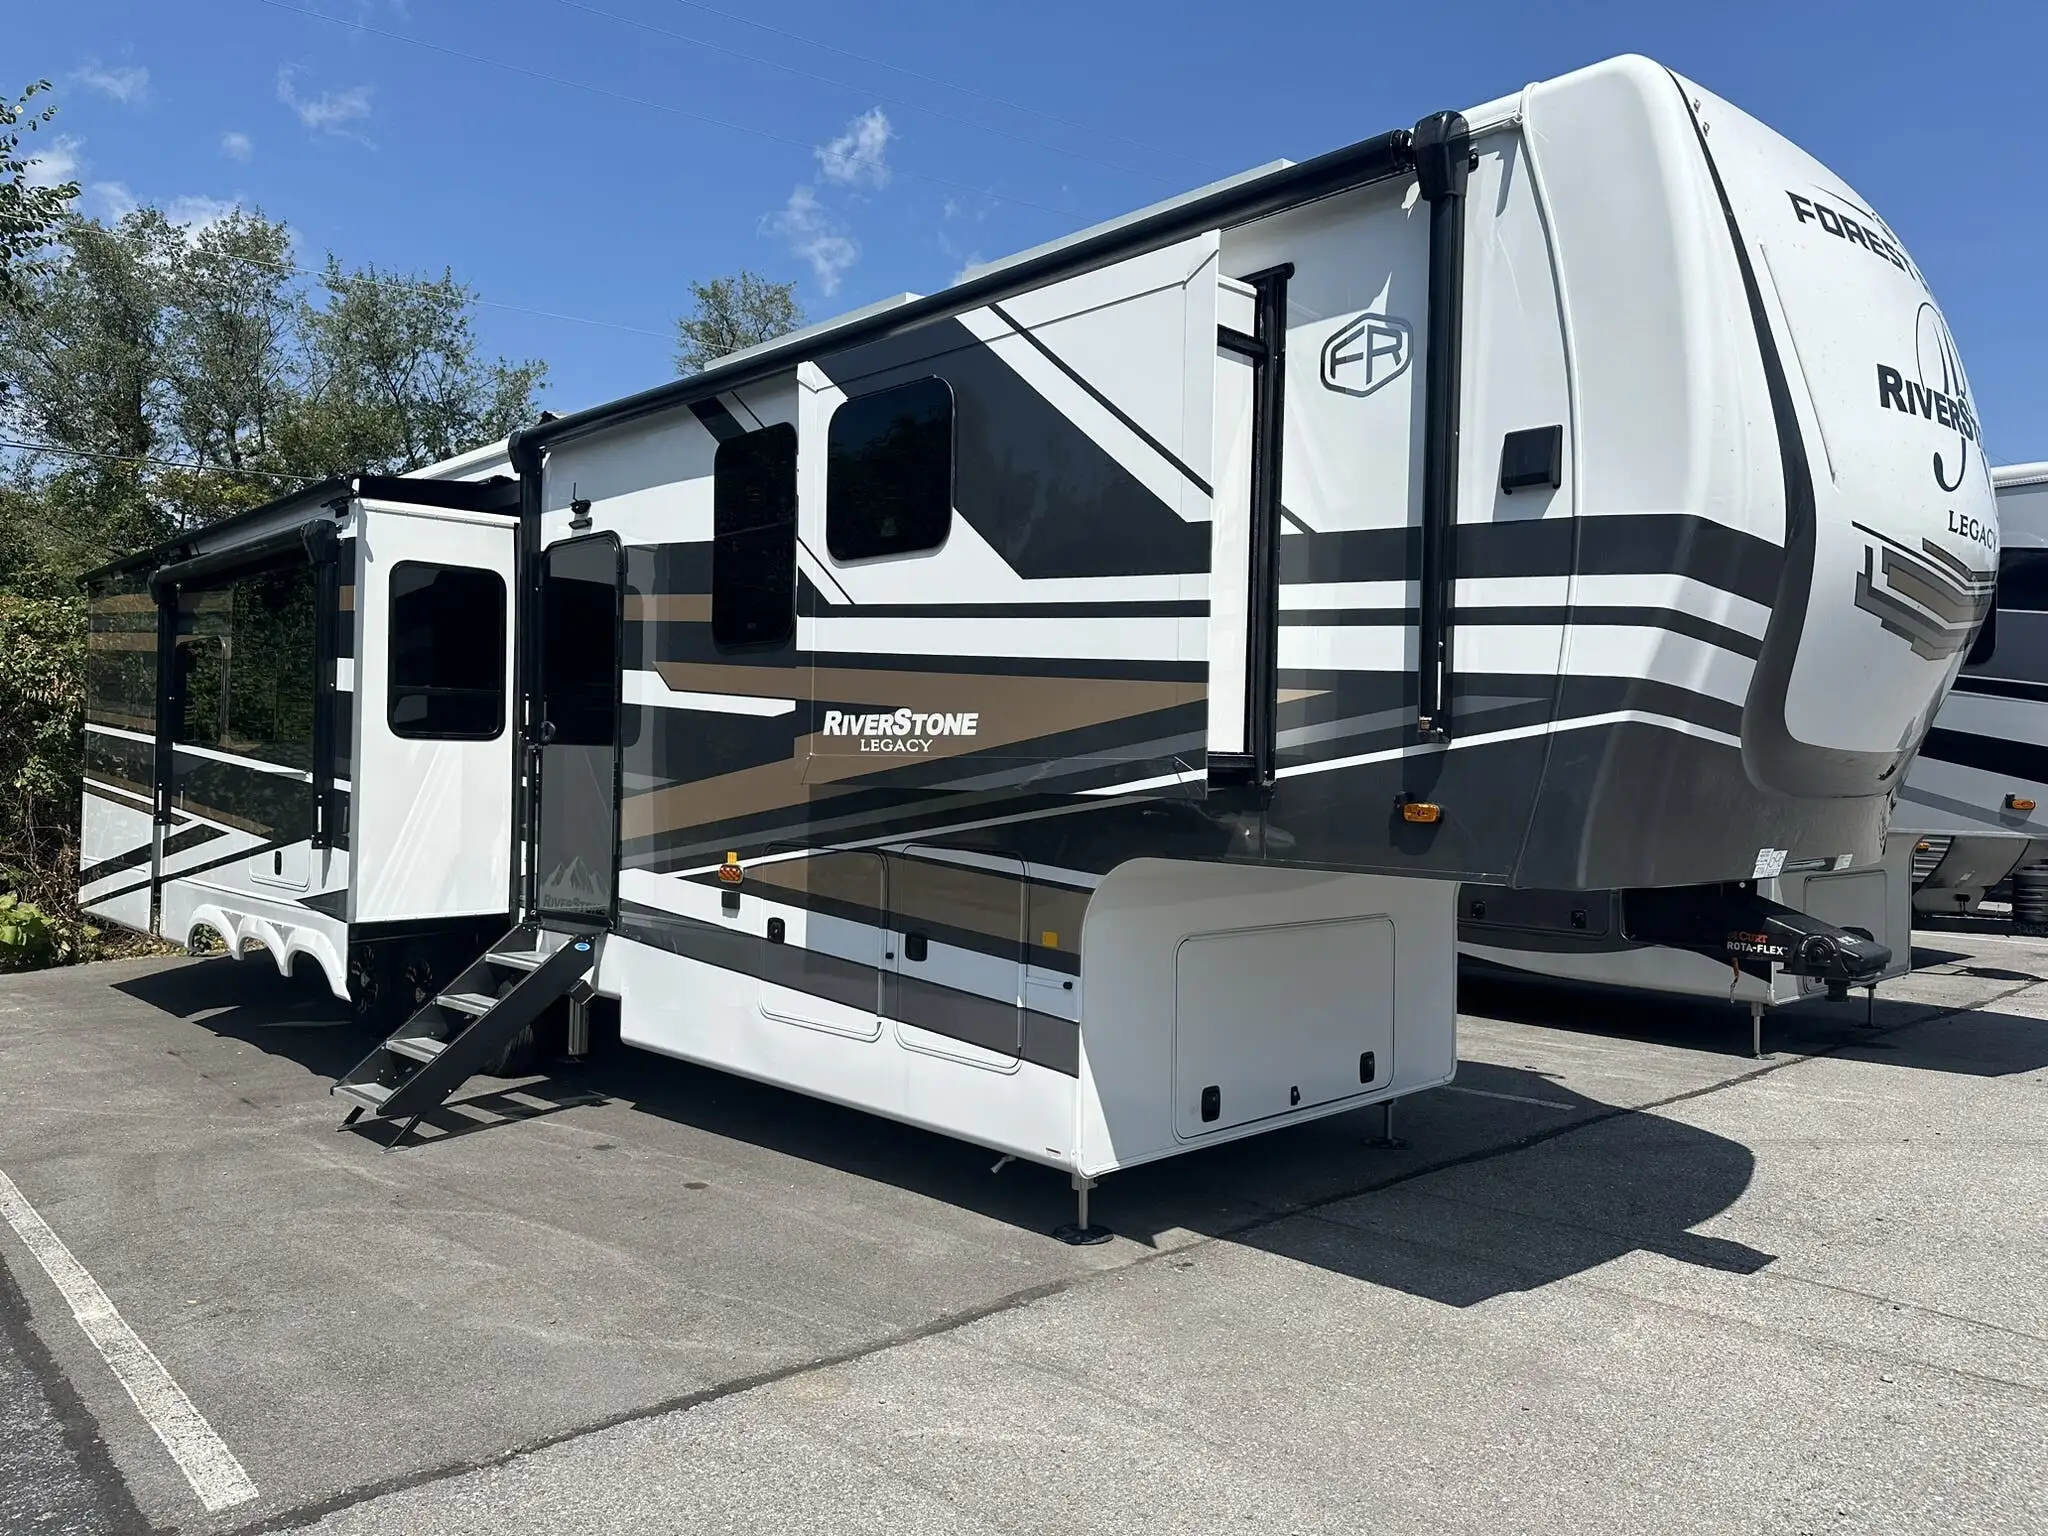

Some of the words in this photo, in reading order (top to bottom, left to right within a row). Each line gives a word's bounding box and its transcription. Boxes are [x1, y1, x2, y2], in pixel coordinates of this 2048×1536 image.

[1784, 190, 1916, 281] FOREST
[1948, 510, 1998, 553] LEGACY
[823, 708, 979, 736] RIVERSTONE
[860, 738, 934, 752] LEGACY
